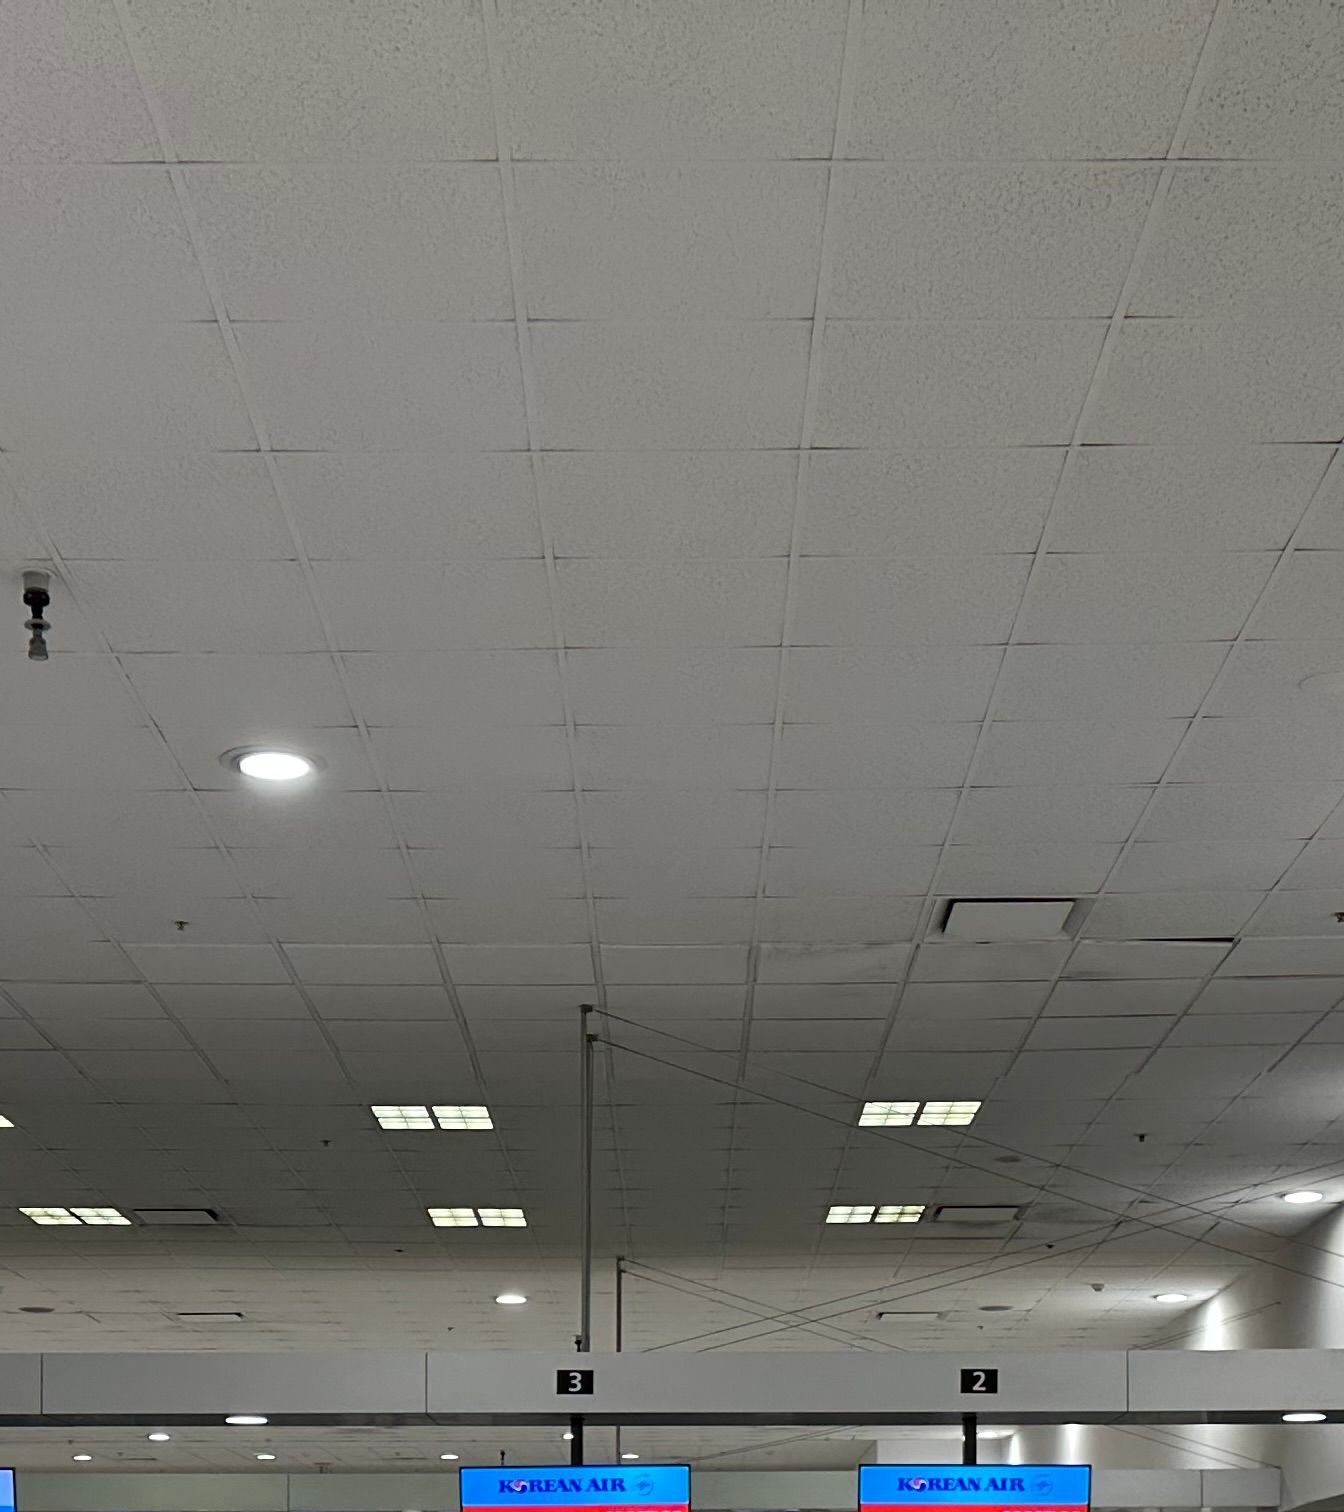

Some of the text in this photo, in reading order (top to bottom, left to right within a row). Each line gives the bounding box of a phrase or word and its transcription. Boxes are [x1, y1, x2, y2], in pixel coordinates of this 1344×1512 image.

[568, 1372, 582, 1392] 3
[972, 1371, 986, 1391] 2
[498, 1477, 627, 1494] KOREAN AIR
[897, 1476, 1025, 1493] KOREAN AIR
